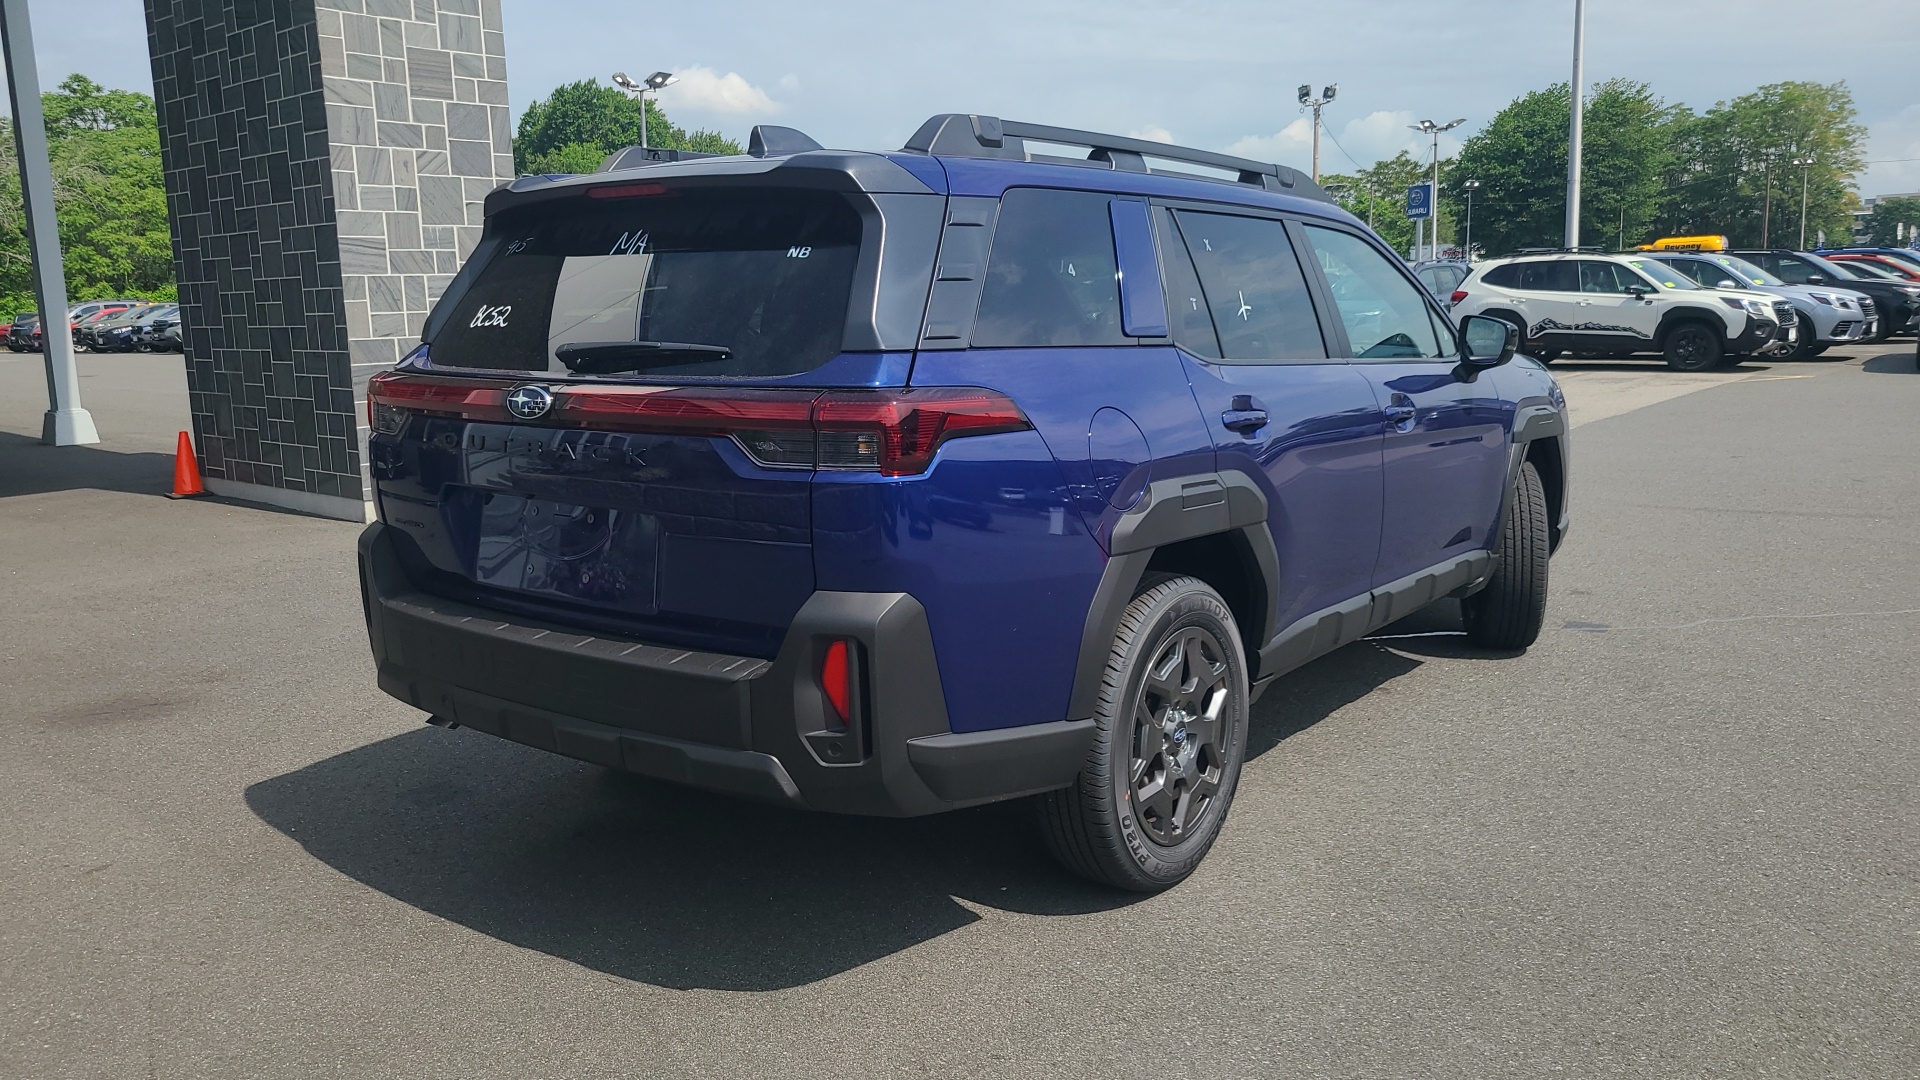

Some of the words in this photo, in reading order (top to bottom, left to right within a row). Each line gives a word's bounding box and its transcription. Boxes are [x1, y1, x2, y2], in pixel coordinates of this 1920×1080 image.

[1407, 207, 1427, 215] SUBARU
[609, 229, 649, 256] MA
[786, 246, 812, 258] NB
[443, 432, 648, 467] OUTBACK
[1179, 597, 1230, 623] DUNLOP
[1121, 814, 1152, 867] PT20
